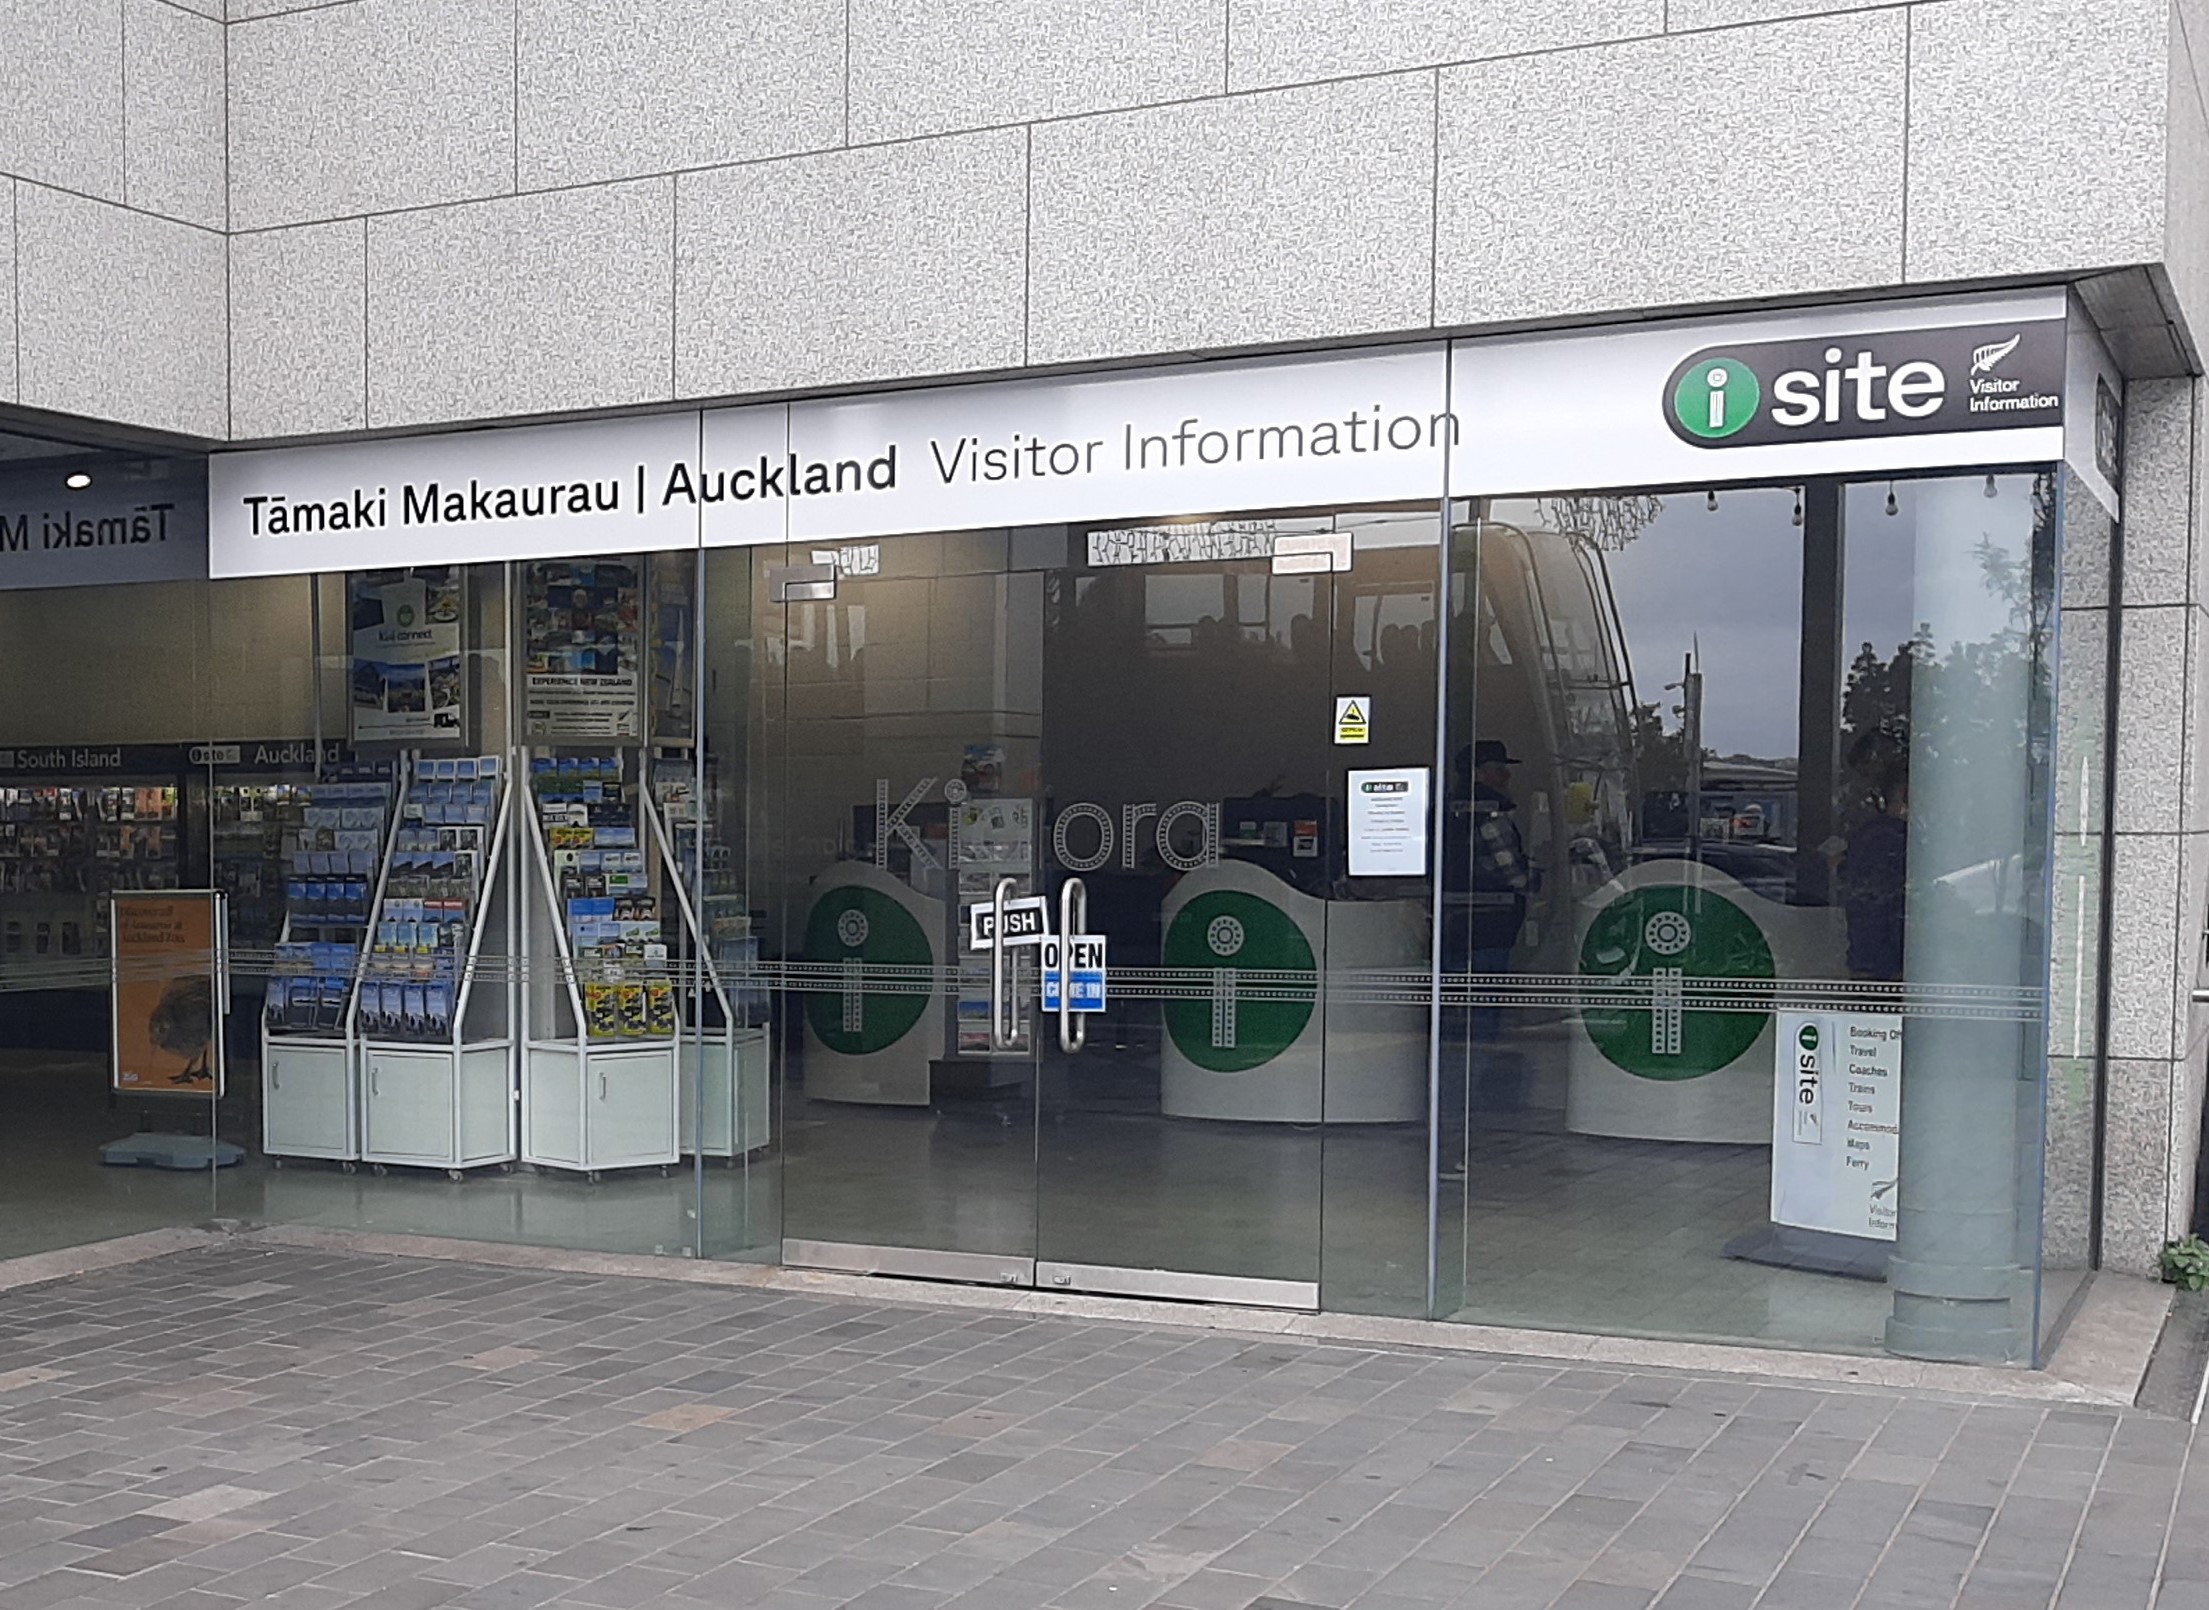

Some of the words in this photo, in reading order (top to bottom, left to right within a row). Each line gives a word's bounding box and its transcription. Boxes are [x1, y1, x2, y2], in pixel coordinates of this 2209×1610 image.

[1771, 347, 1945, 427] site
[1969, 378, 2020, 394] Visitor
[1969, 392, 2059, 412] Information
[243, 487, 386, 535] Tāmaki
[403, 480, 619, 525] Makaurau
[662, 445, 896, 505] Auckland
[931, 434, 1104, 484] Visitor
[1125, 404, 1460, 470] Information
[17, 748, 66, 768] South
[71, 747, 121, 768] Island
[254, 743, 339, 764] Auckland
[1053, 801, 1220, 872] ora
[1850, 1026, 1887, 1041] Booking
[1850, 1044, 1877, 1057] Travel
[1848, 1064, 1888, 1077] Coaches
[1799, 1054, 1819, 1105] site
[1848, 1082, 1876, 1095] Trains
[1848, 1101, 1873, 1113] Tours
[1847, 1138, 1870, 1151] Maps
[1846, 1156, 1870, 1171] Ferry
